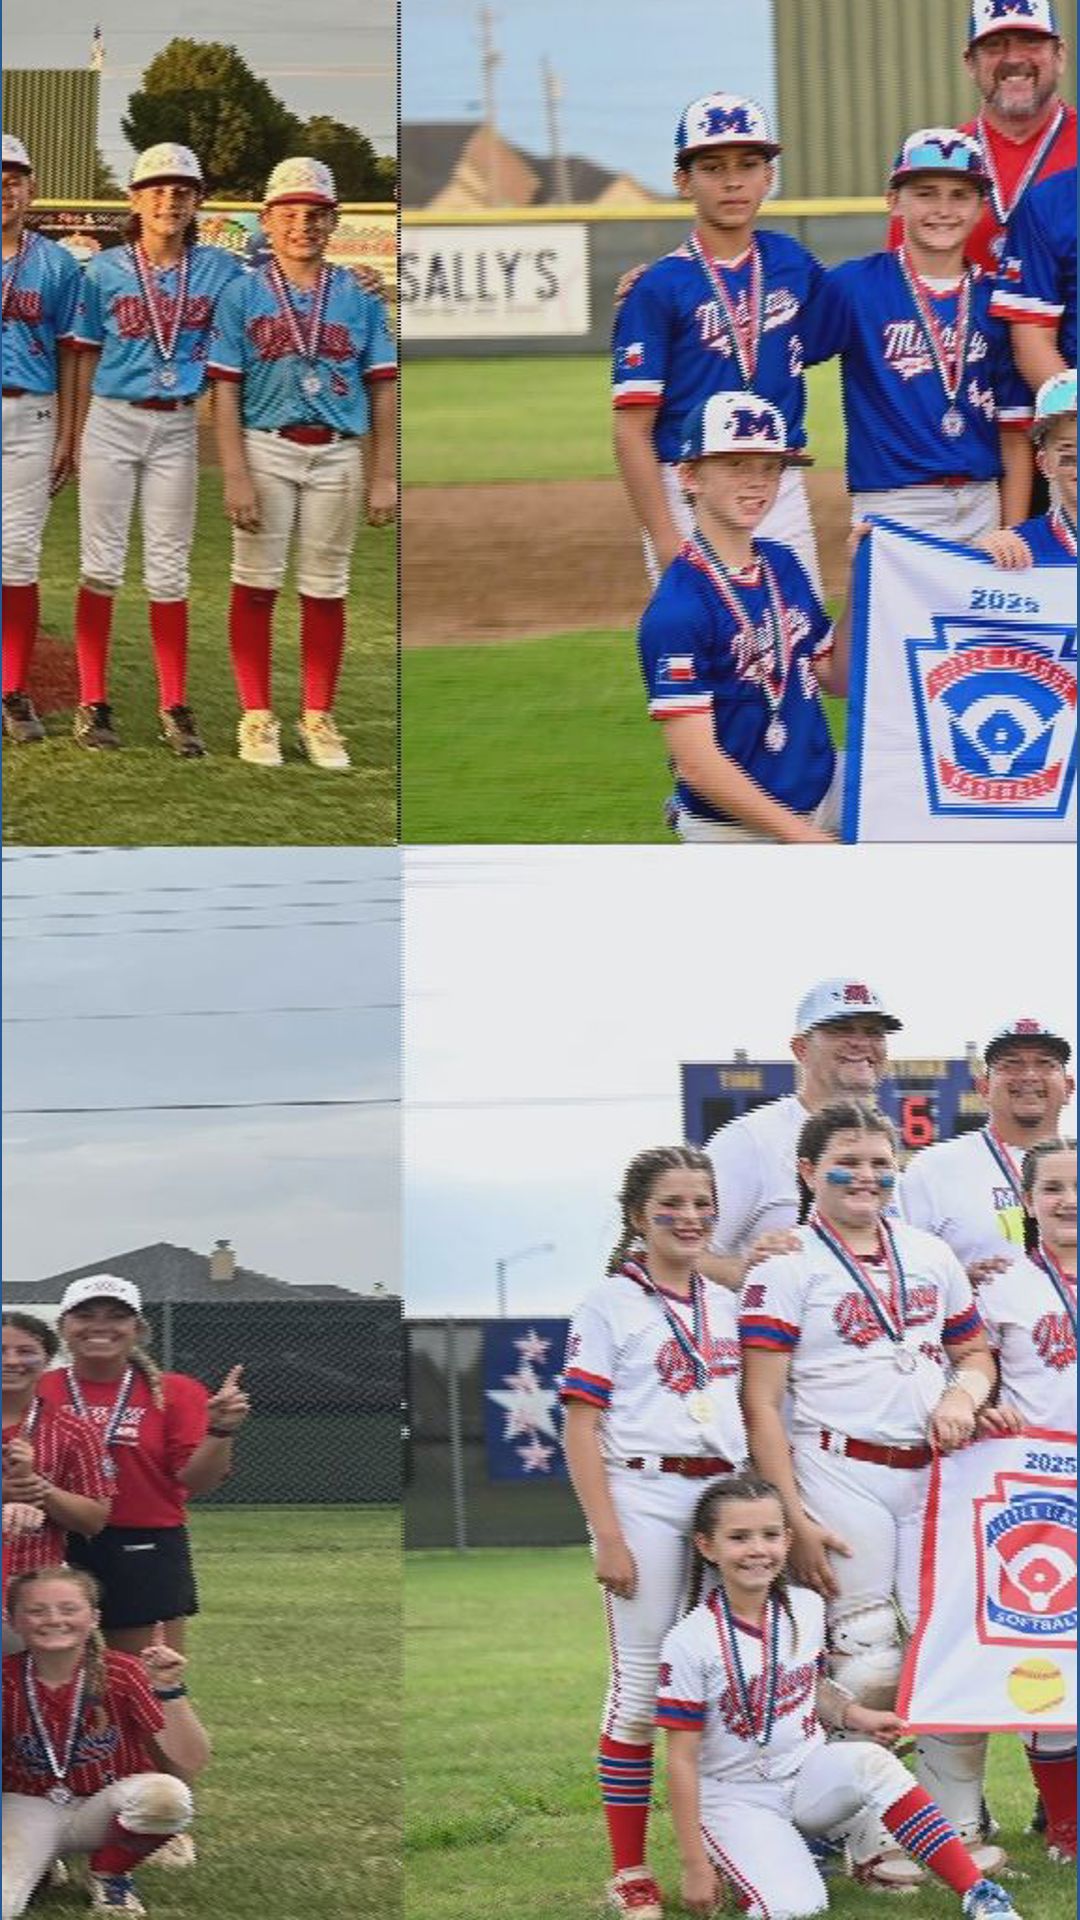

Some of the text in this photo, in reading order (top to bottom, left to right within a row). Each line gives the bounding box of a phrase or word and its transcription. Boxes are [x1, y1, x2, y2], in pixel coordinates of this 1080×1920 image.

[705, 106, 754, 137] M
[733, 408, 781, 440] M
[970, 587, 1040, 613] 2025
[902, 1095, 934, 1147] 6
[1024, 1452, 1076, 1473] 2025
[995, 1611, 1076, 1633] SOFTBAL
